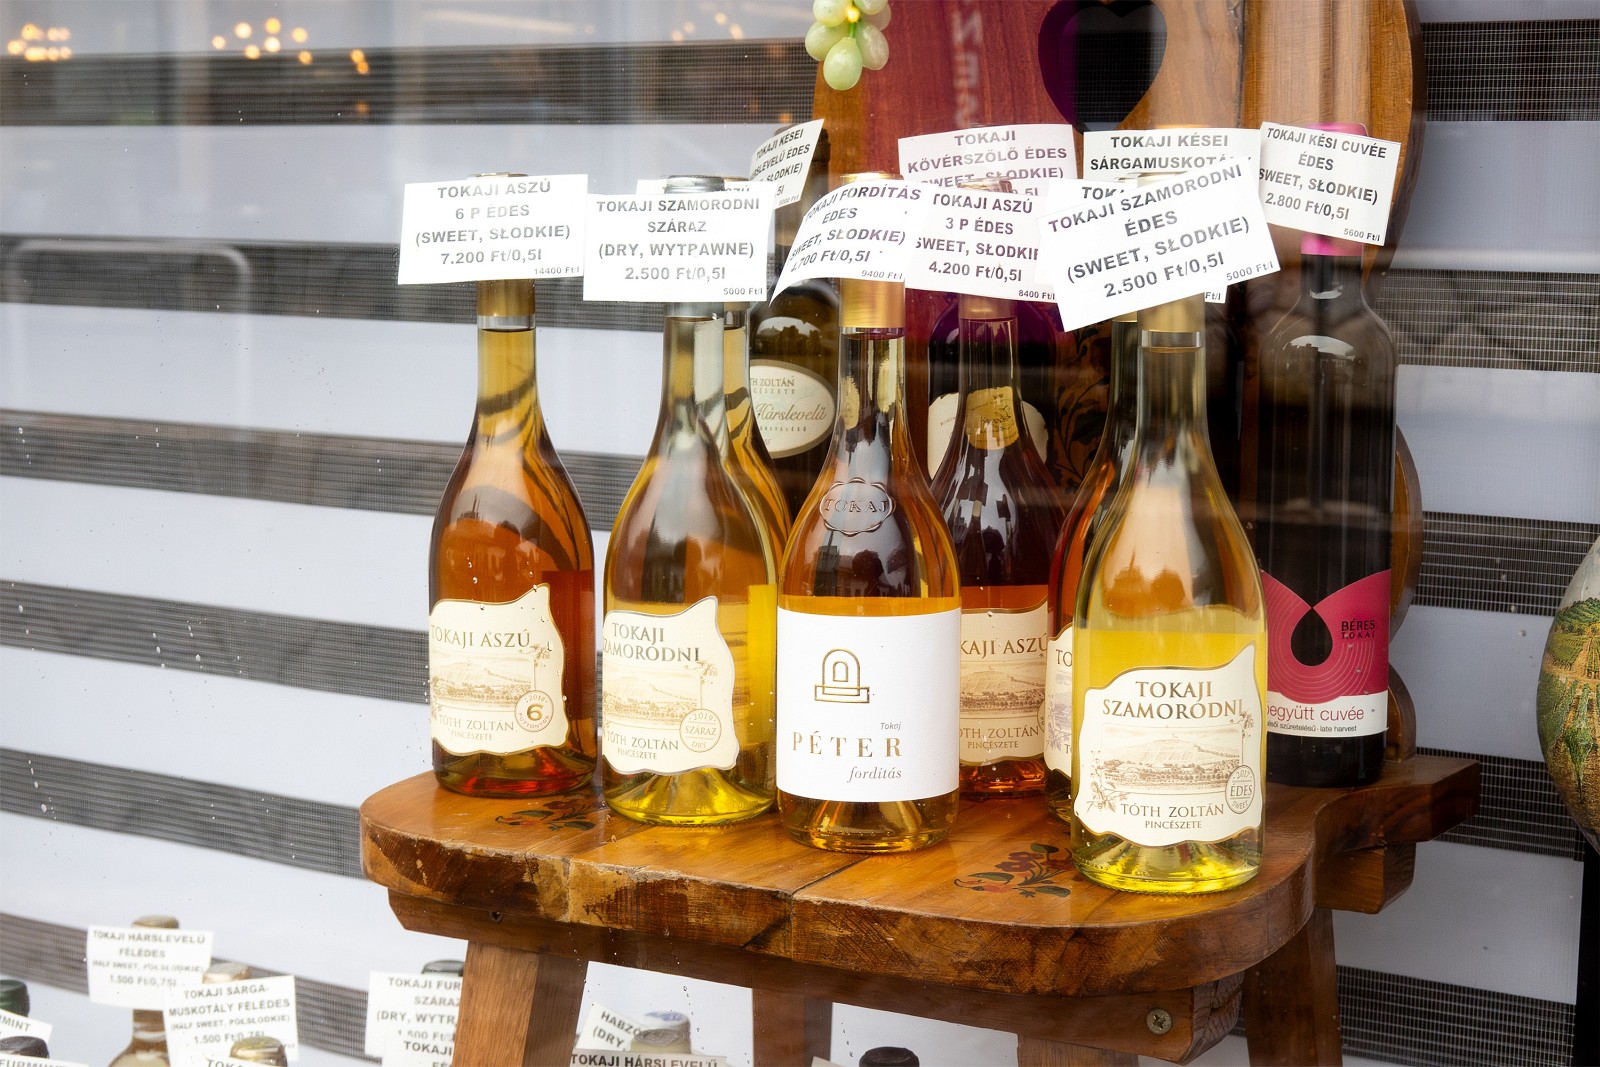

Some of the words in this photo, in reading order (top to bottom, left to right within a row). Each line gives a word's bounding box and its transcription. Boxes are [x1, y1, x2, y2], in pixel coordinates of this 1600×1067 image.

[954, 130, 1016, 146] TOKAJI
[1111, 136, 1171, 148] TOKAJI
[1177, 134, 1229, 148] KÉSEI
[1267, 127, 1307, 144] TOKAJI
[1308, 133, 1338, 150] KÉSI
[1341, 140, 1387, 159] CUVÉE
[1025, 147, 1068, 160] ÉDES
[1298, 151, 1334, 171] ÉDES
[438, 185, 499, 199] TOKAJI
[505, 178, 551, 196] ASZÚ
[1308, 178, 1378, 206] SŁODKIE)
[596, 200, 652, 212] TOKAJI
[658, 198, 760, 212] SZAMORODNI
[805, 193, 839, 222] TOKAJI
[840, 184, 921, 201] FORDÍTÁS
[933, 193, 988, 210] TOKAJI
[992, 198, 1033, 214] ASZÚ
[1048, 203, 1115, 233] TOKAJI
[1120, 164, 1243, 212] SZAMORODNI
[1265, 192, 1301, 210] 2.800
[1304, 200, 1350, 220] Ft/0,5l
[455, 208, 464, 220] 6
[470, 207, 480, 219] P
[486, 204, 530, 218] ÉDES
[822, 207, 858, 224] ÉDES
[647, 219, 707, 233] SZÁRAZ
[945, 217, 954, 230] 3
[959, 218, 969, 231] P
[974, 217, 1014, 235] ÉDES
[1124, 210, 1178, 238] ÉDES
[416, 229, 483, 247] (SWEET,
[489, 224, 571, 240] SŁODKIE)
[827, 229, 906, 245] SŁODKIE)
[1343, 228, 1365, 239] 5600
[440, 251, 485, 265] 7.200
[490, 249, 542, 264] Ft/0,5l
[598, 243, 644, 259] (DRY,
[650, 242, 754, 258] WYTPAWNE)
[820, 249, 870, 263] Ft/0,5l
[1067, 247, 1149, 284] (SWEET,
[1154, 216, 1250, 257] SŁODKIE)
[534, 266, 562, 275] 14400
[624, 267, 670, 280] 2.500
[676, 266, 726, 283] Ft/0,5l
[861, 270, 885, 279] 9400
[928, 261, 971, 276] 4.200
[975, 265, 1022, 283] Ft/0,5l
[1103, 271, 1158, 298] 2.500
[1163, 251, 1225, 281] Ft/0,5l
[1226, 267, 1253, 281] 5000
[1256, 260, 1274, 273] Ft/l
[723, 287, 746, 296] 5000
[1018, 290, 1039, 299] 8400
[759, 376, 795, 387] ZOLTÁN
[824, 498, 888, 513] TOKAJ
[1341, 618, 1375, 632] BÉRES
[431, 625, 474, 649] TOKAJI
[481, 629, 531, 648] ASZÚ
[612, 622, 664, 645] TOKAJI
[1135, 681, 1213, 703] TOKAJI
[526, 703, 544, 722] 6
[1102, 699, 1243, 720] SZAMORODNI
[1320, 706, 1365, 721] cuvée
[466, 718, 515, 731] ZOLTÁN
[685, 724, 717, 736] SZÁRAZ
[988, 725, 1040, 739] ZOLTÁN
[1319, 724, 1333, 733] late
[1334, 725, 1358, 733] harvest
[606, 729, 627, 744] TÓTH
[631, 736, 679, 750] ZOLTÁN
[792, 731, 902, 758] PÉTER
[967, 740, 1019, 750] PINCÉSZETE
[617, 747, 658, 760] PINCÉSZETE
[847, 766, 902, 783] fordítás
[1229, 783, 1253, 797] ÉDES
[1120, 803, 1161, 818] TÓTH
[1168, 801, 1225, 818] ZOLTÁN
[1145, 820, 1202, 830] PINCÉSZETE
[93, 931, 125, 941] TOKAJI
[128, 932, 206, 945] HÁRSLEVELŰ
[119, 947, 166, 959] FÉLÉDES
[109, 975, 134, 986] 1.500
[388, 977, 432, 989] TOKAJI
[184, 988, 224, 1000] TOKAJI
[168, 1004, 234, 1017] MUSKOTÁLY
[237, 999, 290, 1012] FÉLÉDES
[376, 1010, 411, 1024] (DRY,
[194, 1034, 221, 1045] 1.500
[403, 1041, 452, 1056] TOKAJI
[570, 1054, 619, 1066] TOKAJI
